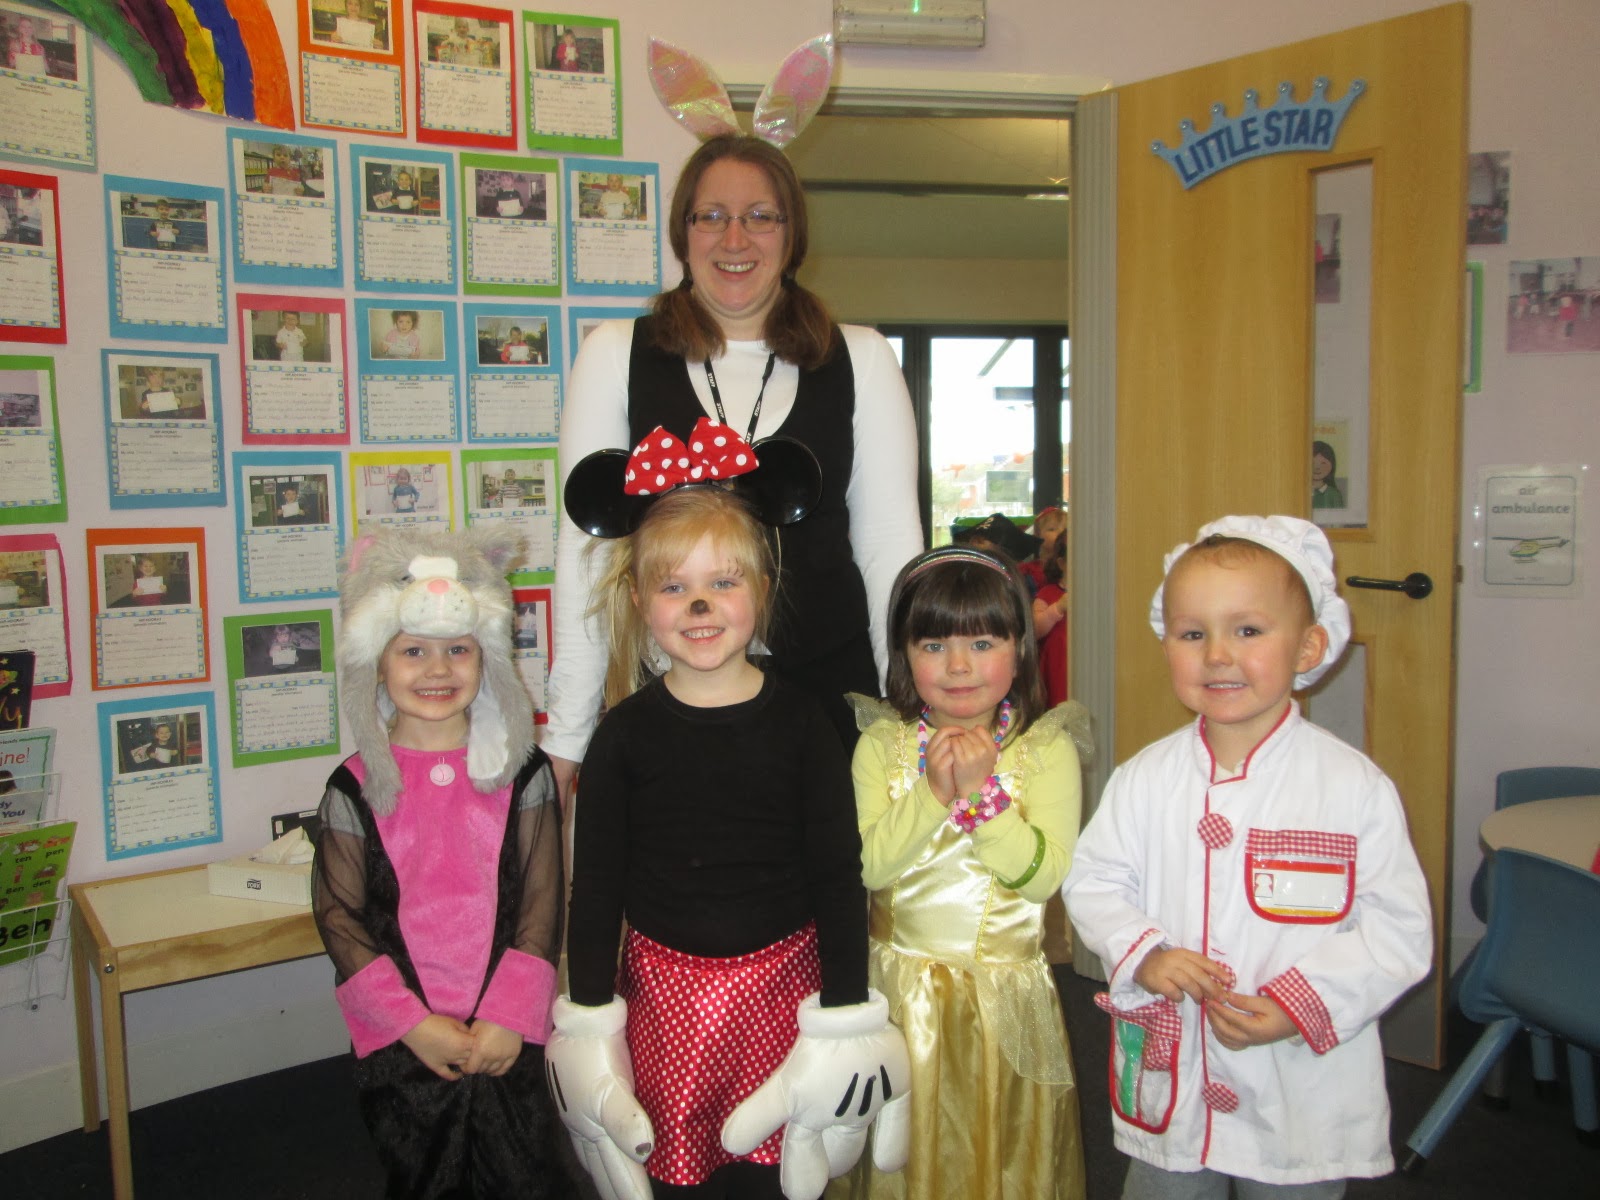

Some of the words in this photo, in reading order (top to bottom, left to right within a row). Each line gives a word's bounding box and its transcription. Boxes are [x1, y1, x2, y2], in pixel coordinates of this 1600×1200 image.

[1174, 116, 1261, 184] LITTLE
[1263, 108, 1335, 148] STAR
[1519, 485, 1539, 496] air
[1492, 503, 1570, 514] ambulance
[2, 809, 26, 819] You
[15, 855, 32, 864] ten
[45, 848, 65, 859] pen
[32, 879, 51, 888] den
